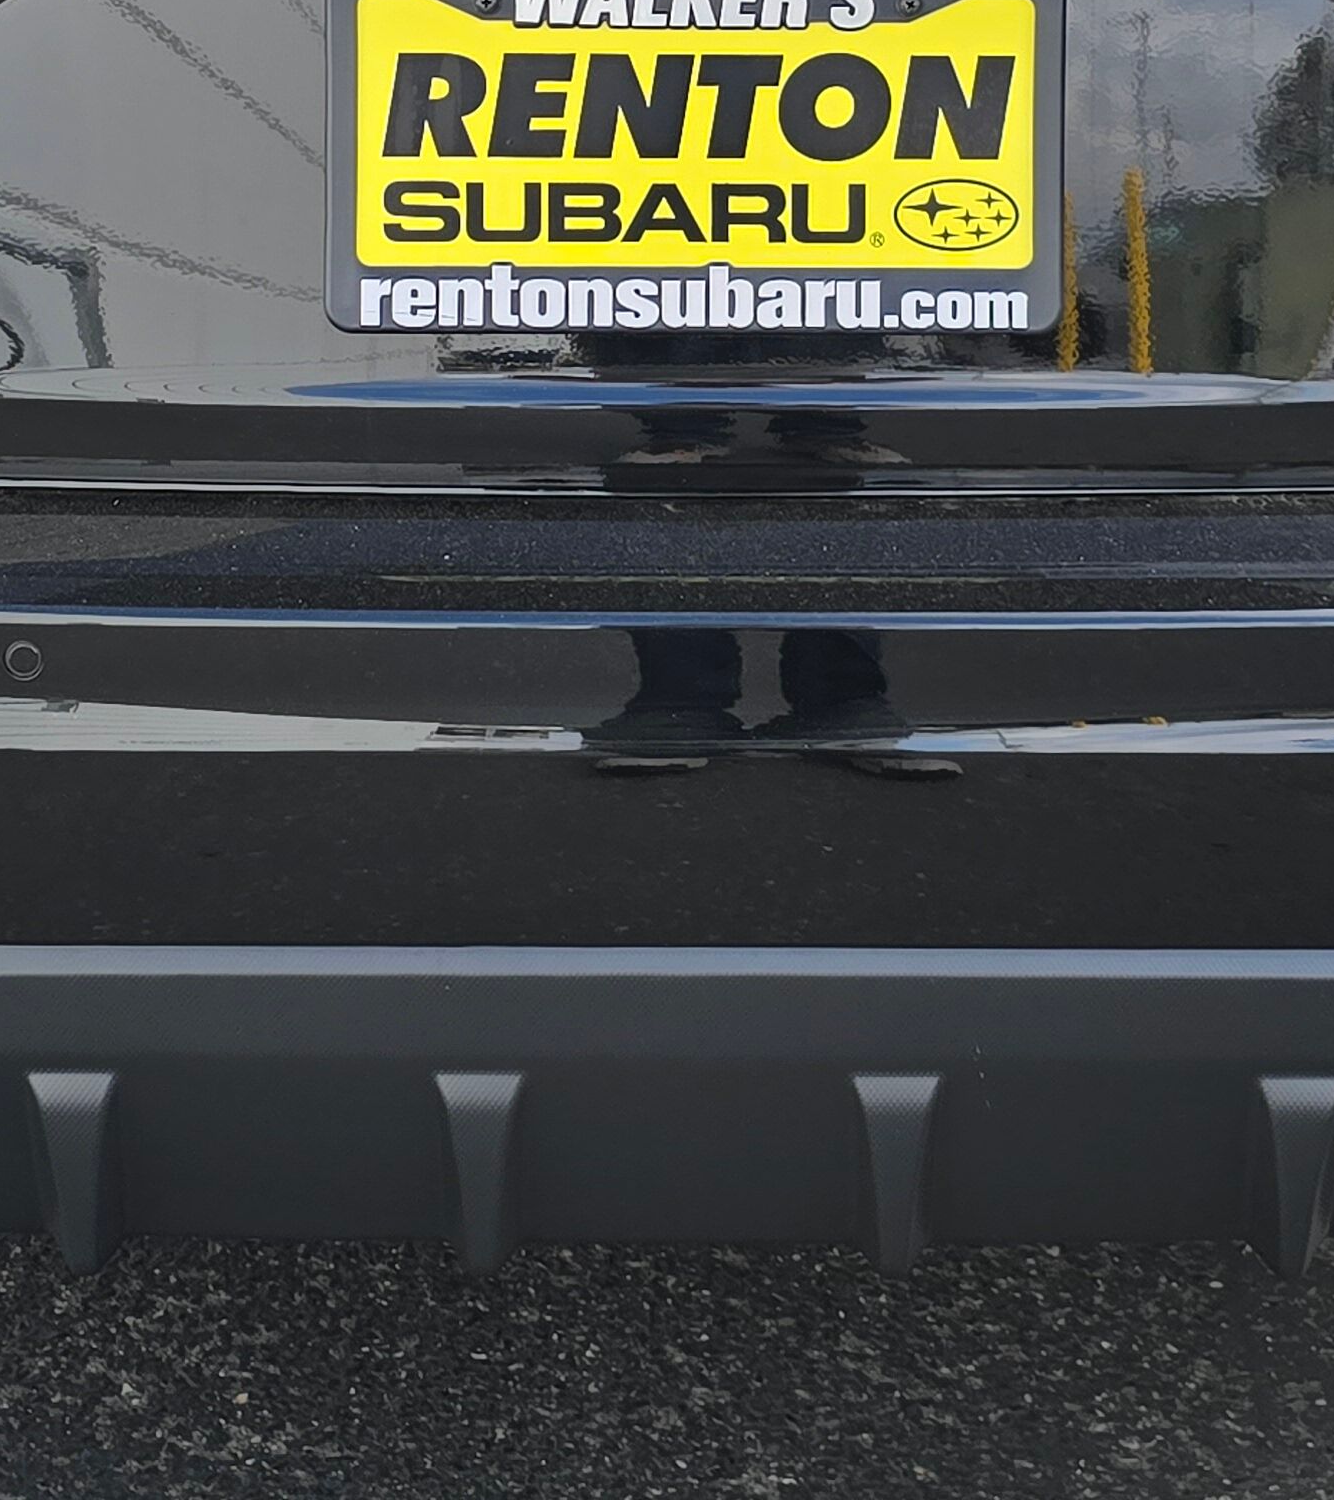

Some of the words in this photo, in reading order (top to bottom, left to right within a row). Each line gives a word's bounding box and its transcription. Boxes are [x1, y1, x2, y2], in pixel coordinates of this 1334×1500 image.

[382, 52, 1015, 162] RENTON
[382, 180, 866, 244] SUBARU
[359, 264, 1028, 331] rentonsubaru.com
